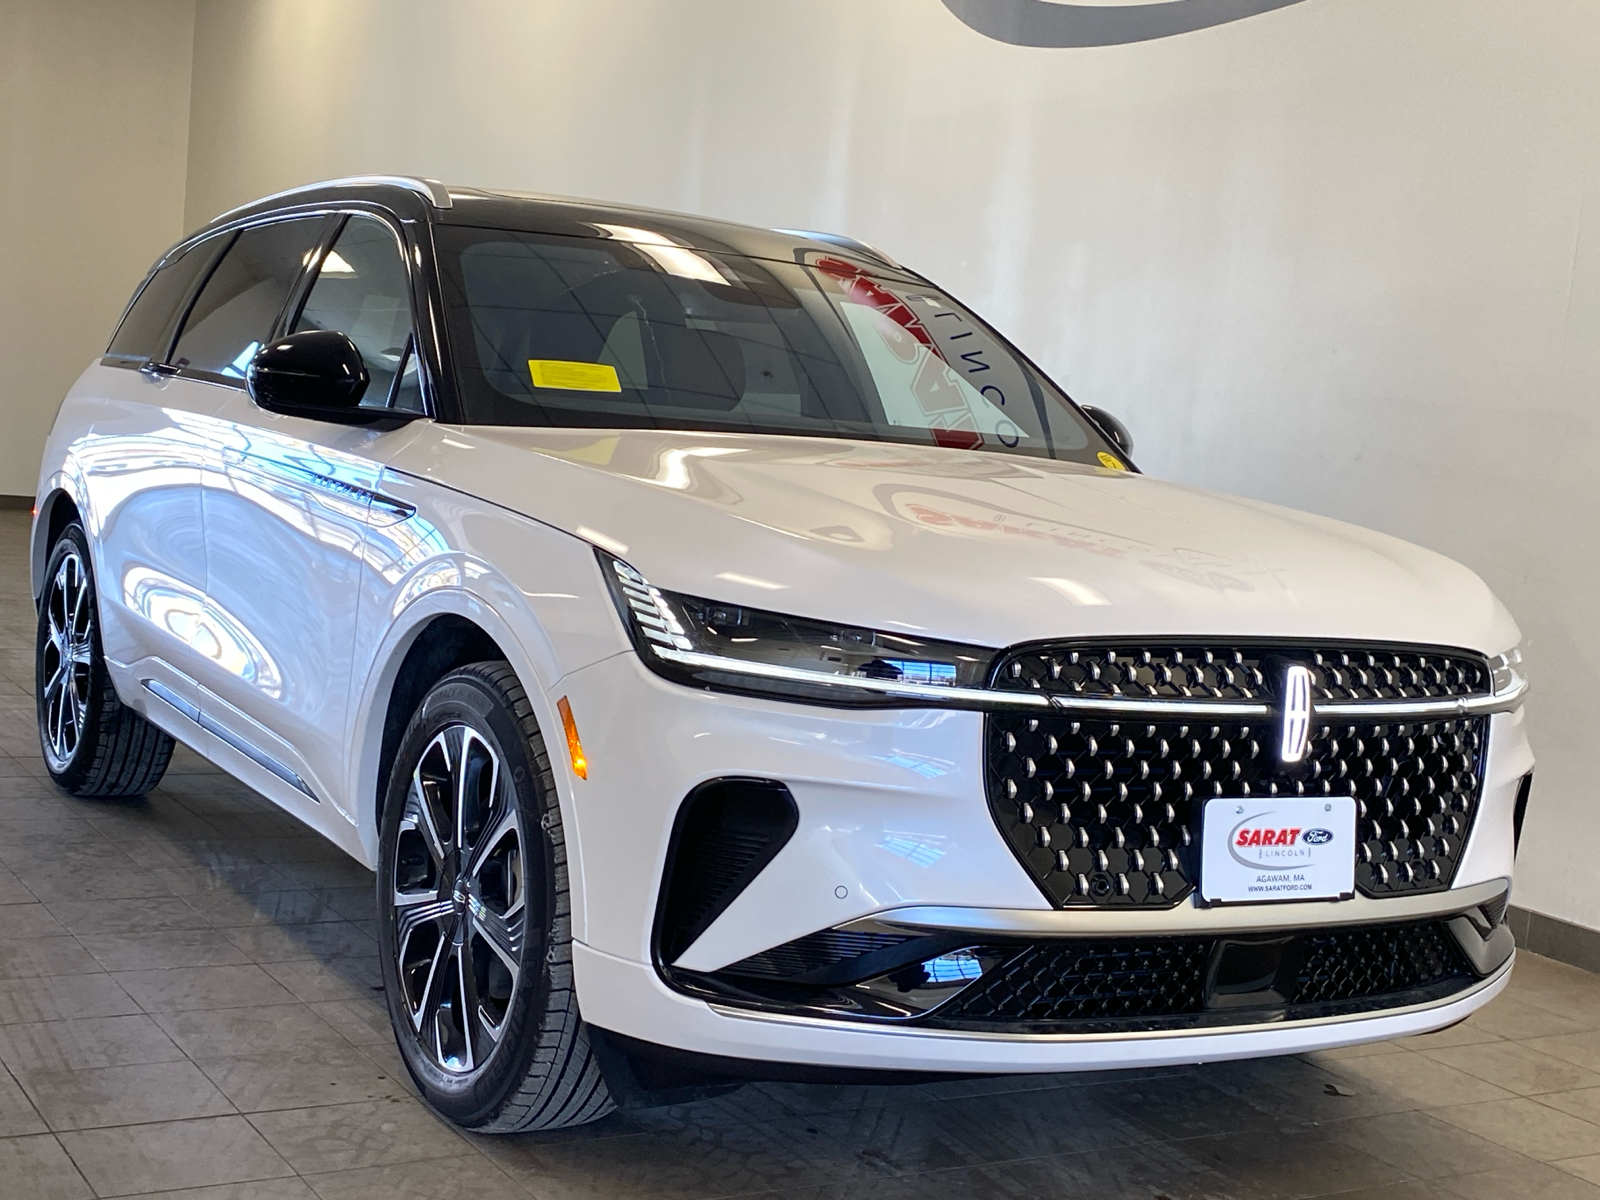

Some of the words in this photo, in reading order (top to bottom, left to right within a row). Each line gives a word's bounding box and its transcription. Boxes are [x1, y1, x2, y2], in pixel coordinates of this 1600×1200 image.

[1236, 828, 1301, 847] SARAT
[1305, 829, 1330, 843] Ford
[1265, 849, 1305, 857] LINCOLN
[1256, 875, 1291, 883] AGAWAM,
[1248, 884, 1312, 892] WWW.SARATFORD.COM
